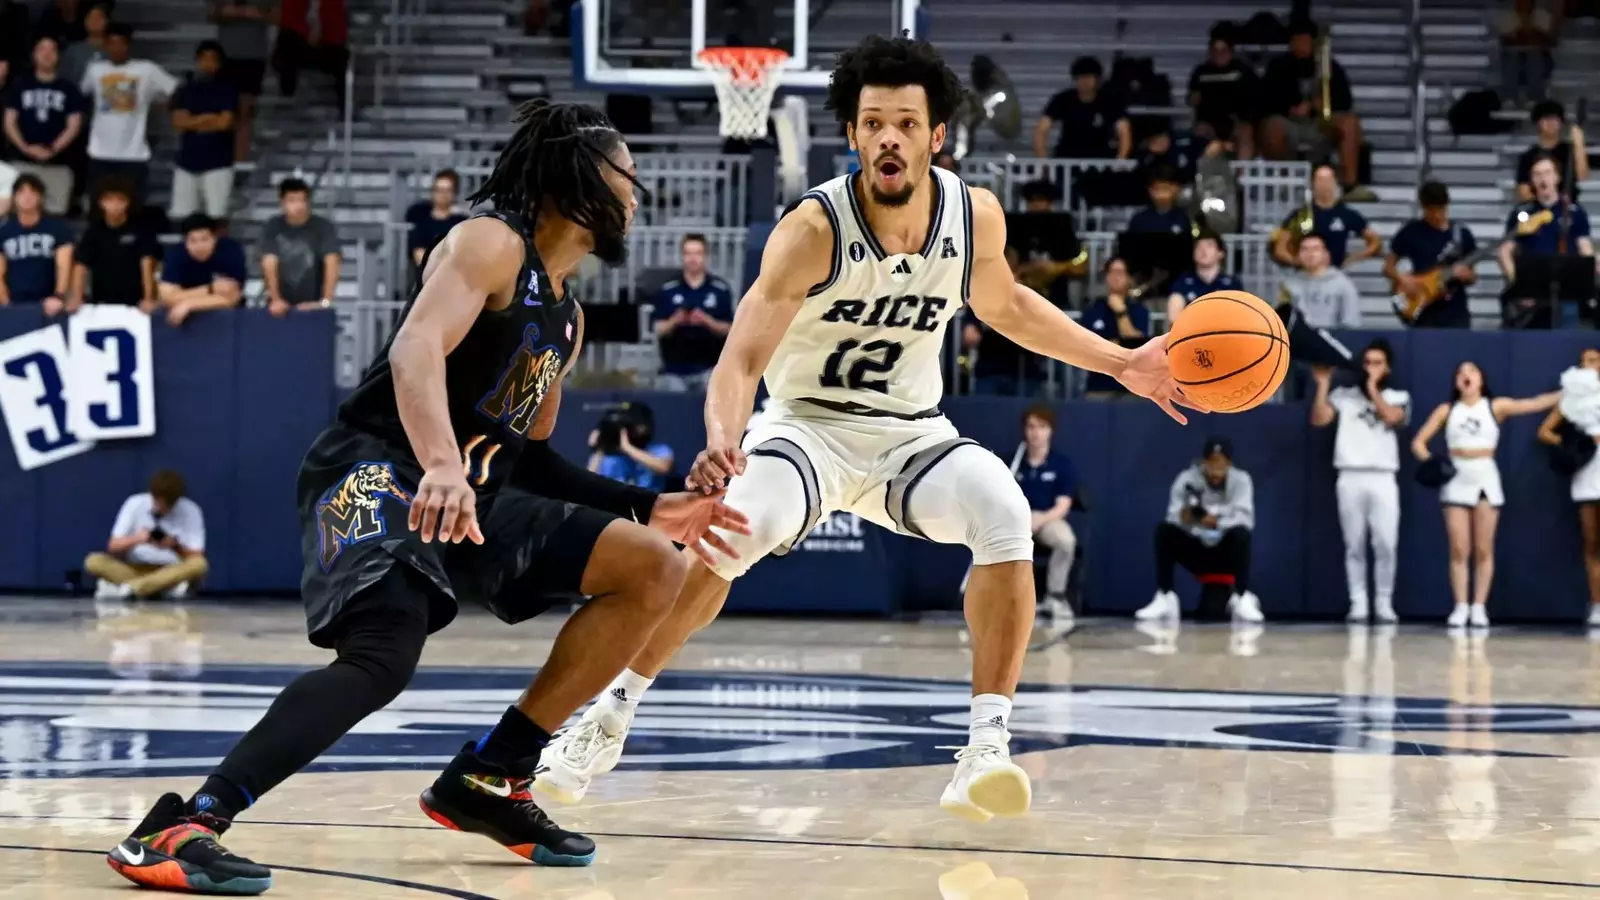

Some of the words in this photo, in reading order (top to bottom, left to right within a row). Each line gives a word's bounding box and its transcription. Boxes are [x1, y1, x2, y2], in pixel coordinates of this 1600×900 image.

[2, 233, 56, 260] RICE
[820, 295, 948, 333] RICE
[818, 337, 905, 394] 12
[4, 350, 79, 453] 3
[84, 327, 140, 429] 3
